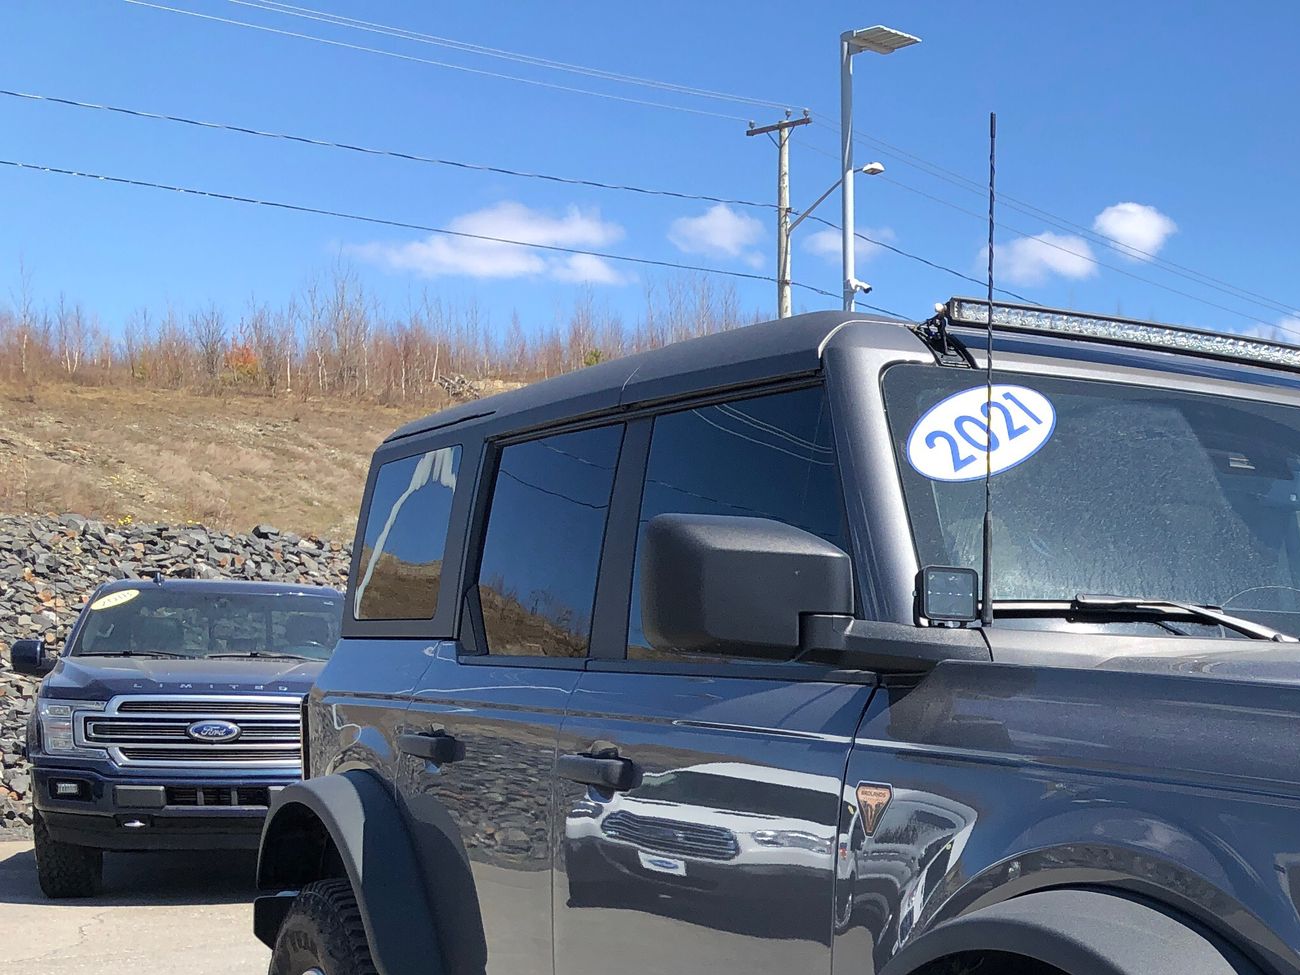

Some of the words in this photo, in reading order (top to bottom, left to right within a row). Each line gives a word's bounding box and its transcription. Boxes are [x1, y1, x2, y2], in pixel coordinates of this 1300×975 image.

[924, 391, 1043, 473] 2021
[133, 683, 288, 691] LIMITED
[200, 725, 227, 737] Ford
